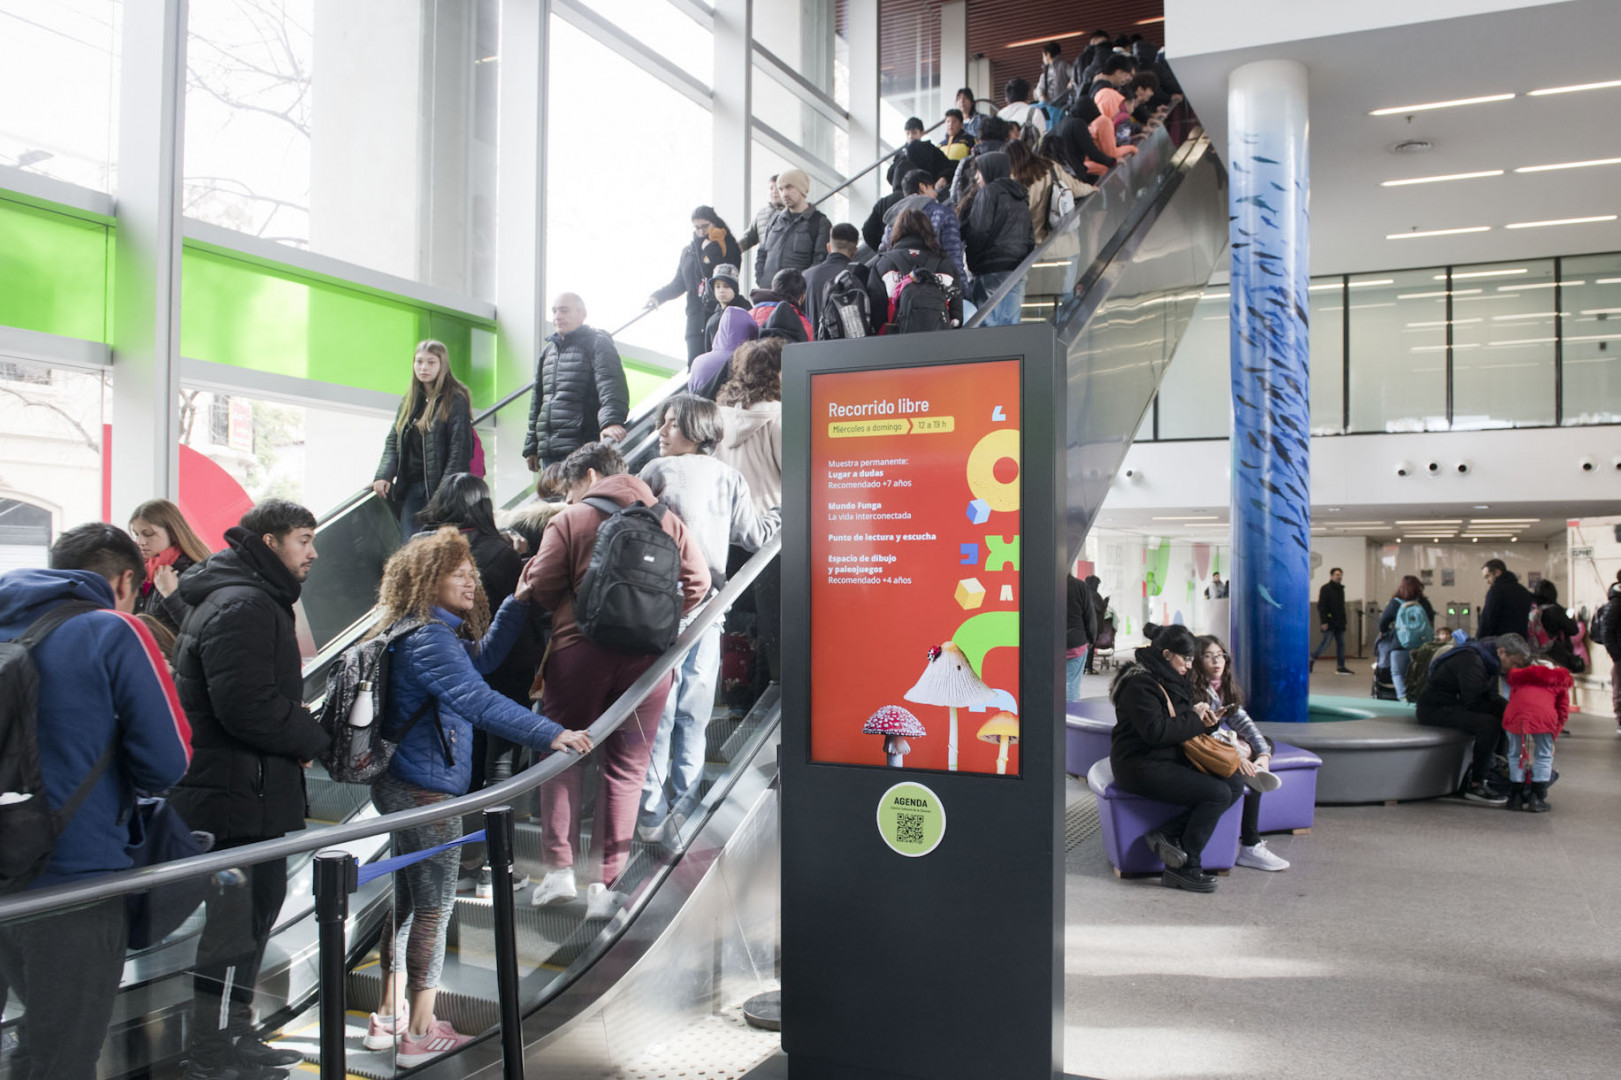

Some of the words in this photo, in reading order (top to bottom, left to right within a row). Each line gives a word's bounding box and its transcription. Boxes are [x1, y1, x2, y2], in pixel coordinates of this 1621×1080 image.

[828, 399, 895, 417] Recorrido
[898, 398, 929, 414] libre
[872, 423, 903, 432] domingo
[918, 421, 925, 429] 12
[933, 420, 941, 428] 19
[942, 420, 947, 428] h
[828, 460, 859, 468] Muestra
[860, 458, 908, 468] permanente:
[828, 470, 851, 480] Lugar
[859, 469, 884, 477] dudas
[828, 480, 881, 489] Recomendado
[882, 479, 892, 487] +7
[893, 479, 912, 487] años
[828, 502, 856, 510] Mundo
[857, 502, 882, 511] Funga
[828, 513, 837, 521] La
[855, 511, 912, 520] interconectada
[828, 533, 852, 541] Punto
[853, 533, 864, 541] de
[865, 533, 894, 541] lectura
[895, 534, 902, 543] y
[902, 532, 937, 540] escucha
[828, 555, 858, 564] Espacio
[859, 554, 870, 562] de
[871, 554, 897, 564] dibujo
[828, 567, 834, 575] y
[834, 565, 883, 575] paleojuegos
[828, 577, 881, 585] Recomendado
[893, 576, 912, 585] años
[894, 797, 928, 808] AGENDA
